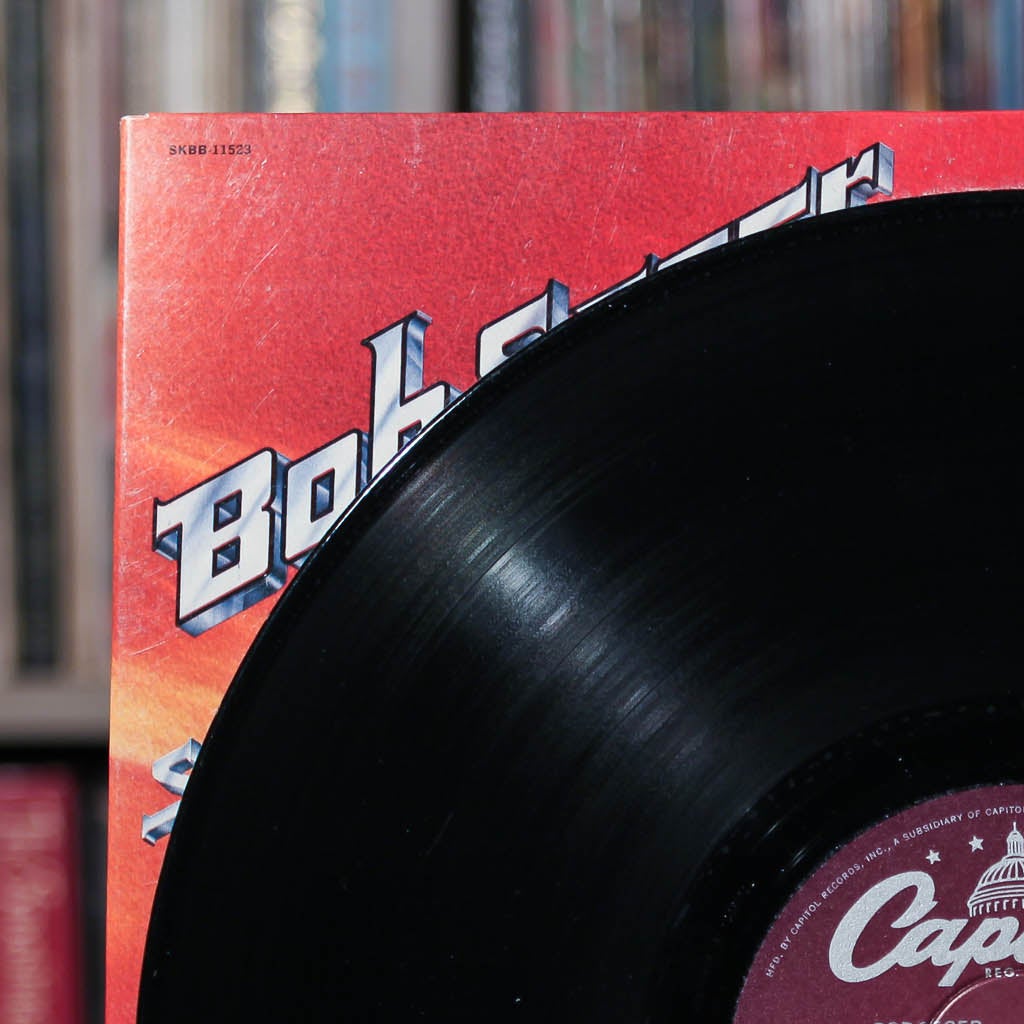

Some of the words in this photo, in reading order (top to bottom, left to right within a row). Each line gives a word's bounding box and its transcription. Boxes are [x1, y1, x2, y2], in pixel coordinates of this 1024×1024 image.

[169, 144, 252, 155] SKBB-11523
[765, 953, 785, 979] MFD.
[779, 935, 793, 951] BY
[790, 900, 823, 936] CAPITOL
[820, 861, 865, 900] RECORDS,
[893, 838, 900, 847] A
[902, 814, 963, 841] SUBSIDIARY
[967, 809, 981, 820] OF
